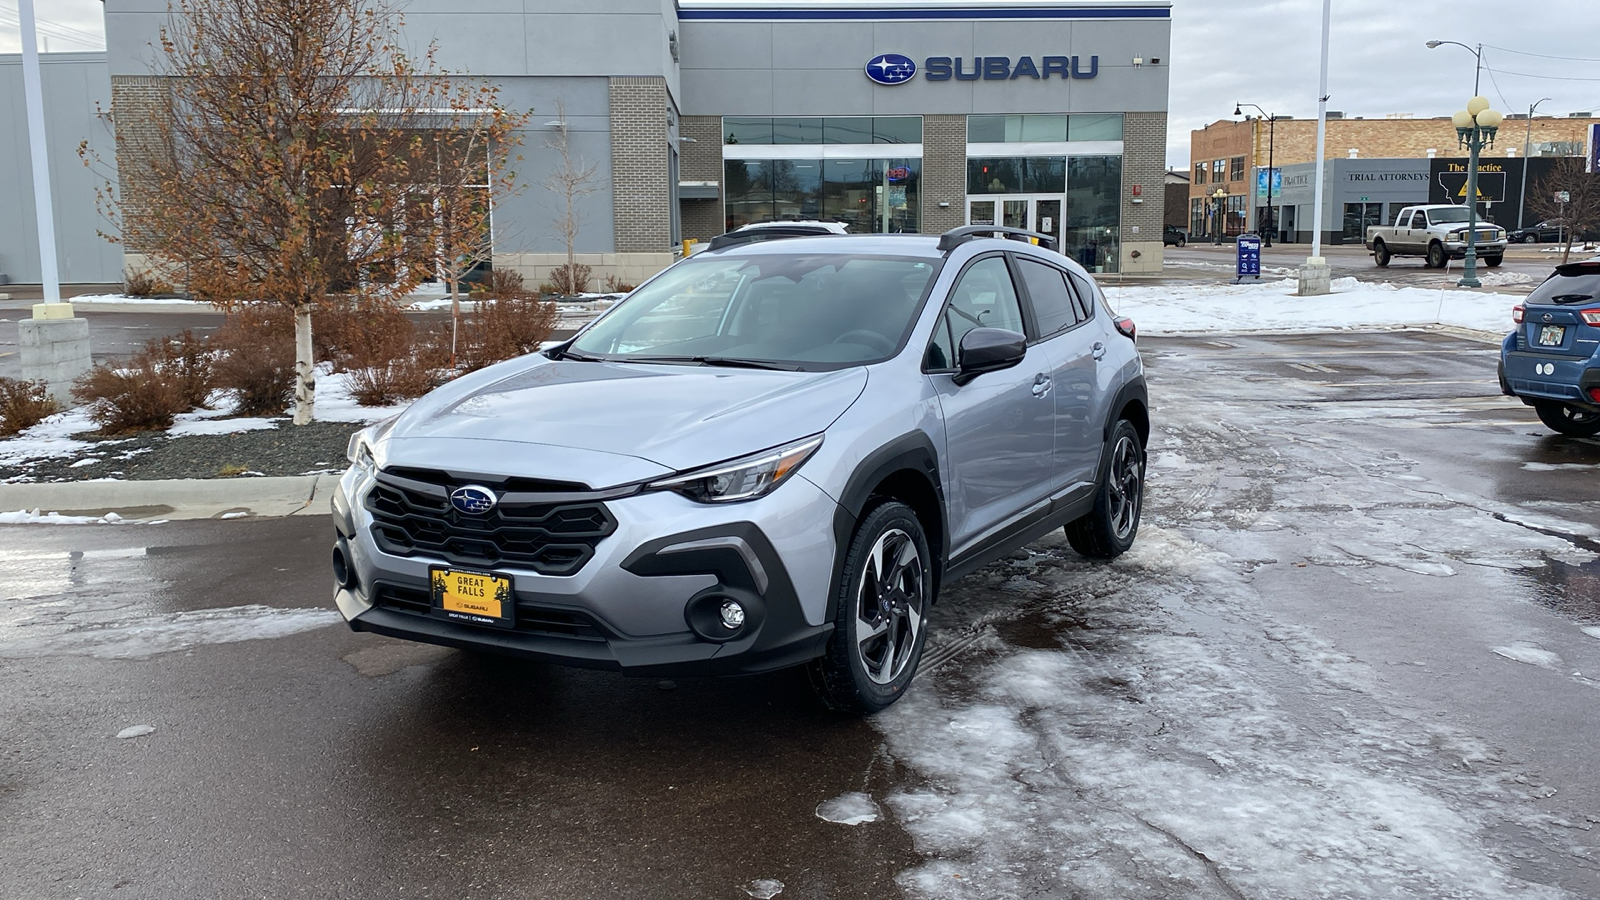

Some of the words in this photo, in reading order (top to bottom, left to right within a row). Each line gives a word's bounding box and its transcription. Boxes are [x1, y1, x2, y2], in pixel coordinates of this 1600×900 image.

[925, 55, 1099, 81] SUBARU
[1448, 163, 1466, 172] The
[1467, 163, 1502, 172] actice
[886, 168, 908, 178] OPEN
[1378, 173, 1430, 181] ATTORNEYS
[1284, 174, 1308, 186] PRACTICE
[458, 576, 484, 588] GREAT
[458, 586, 484, 597] FALLS
[464, 604, 488, 612] SUBARU
